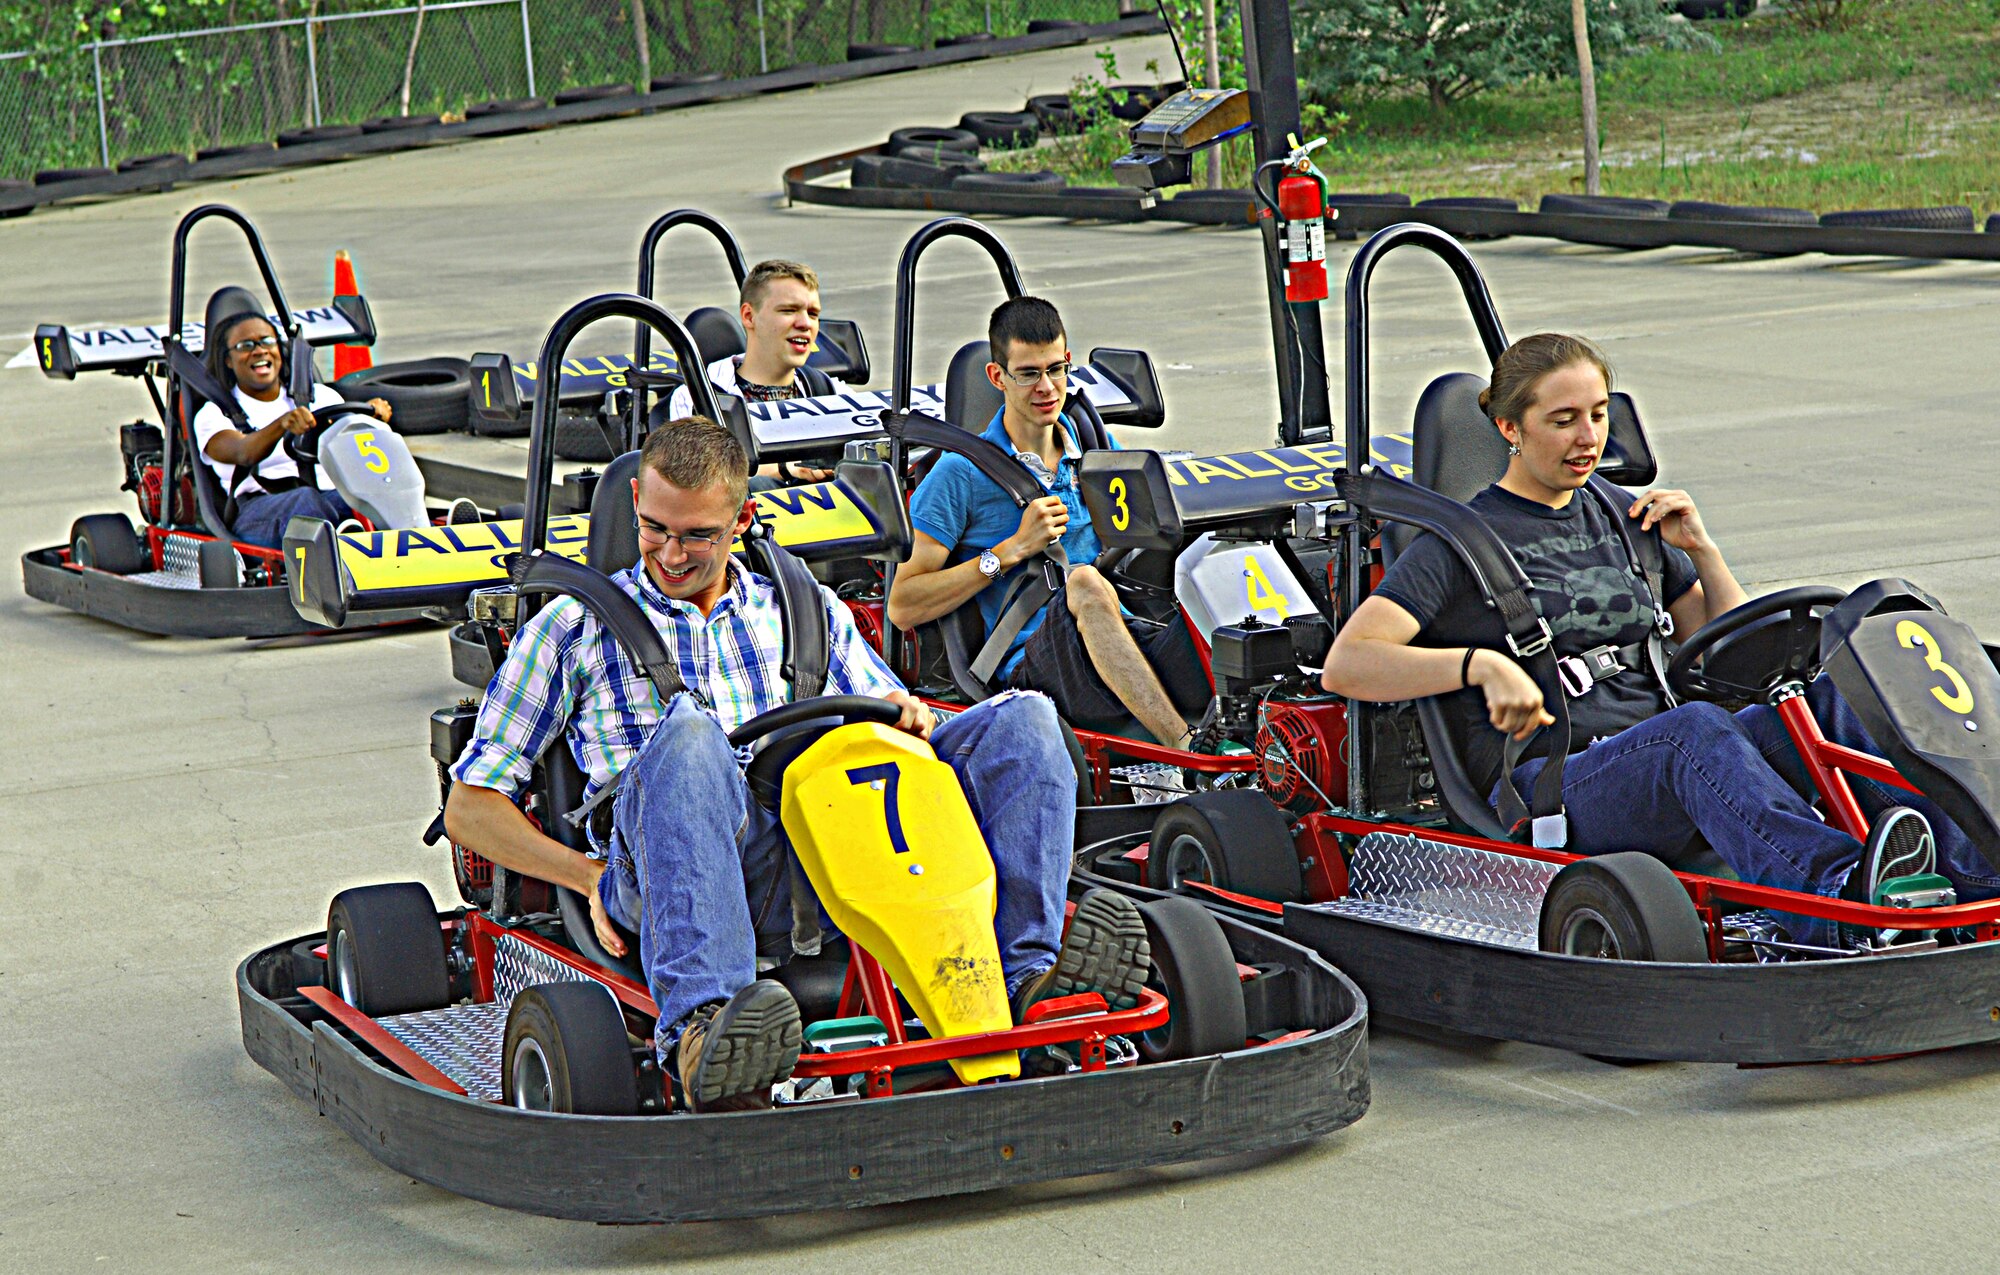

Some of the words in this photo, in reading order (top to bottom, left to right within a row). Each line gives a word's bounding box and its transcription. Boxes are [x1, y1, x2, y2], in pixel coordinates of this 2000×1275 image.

[43, 337, 53, 369] 5
[70, 322, 205, 346] VALLE
[481, 370, 491, 408] 1
[353, 432, 390, 474] 5
[1109, 477, 1130, 531] 3
[338, 512, 592, 559] VALLE
[295, 546, 306, 602] 7
[1244, 555, 1290, 621] 4
[1895, 619, 1975, 715] 3
[845, 761, 910, 854] 7
